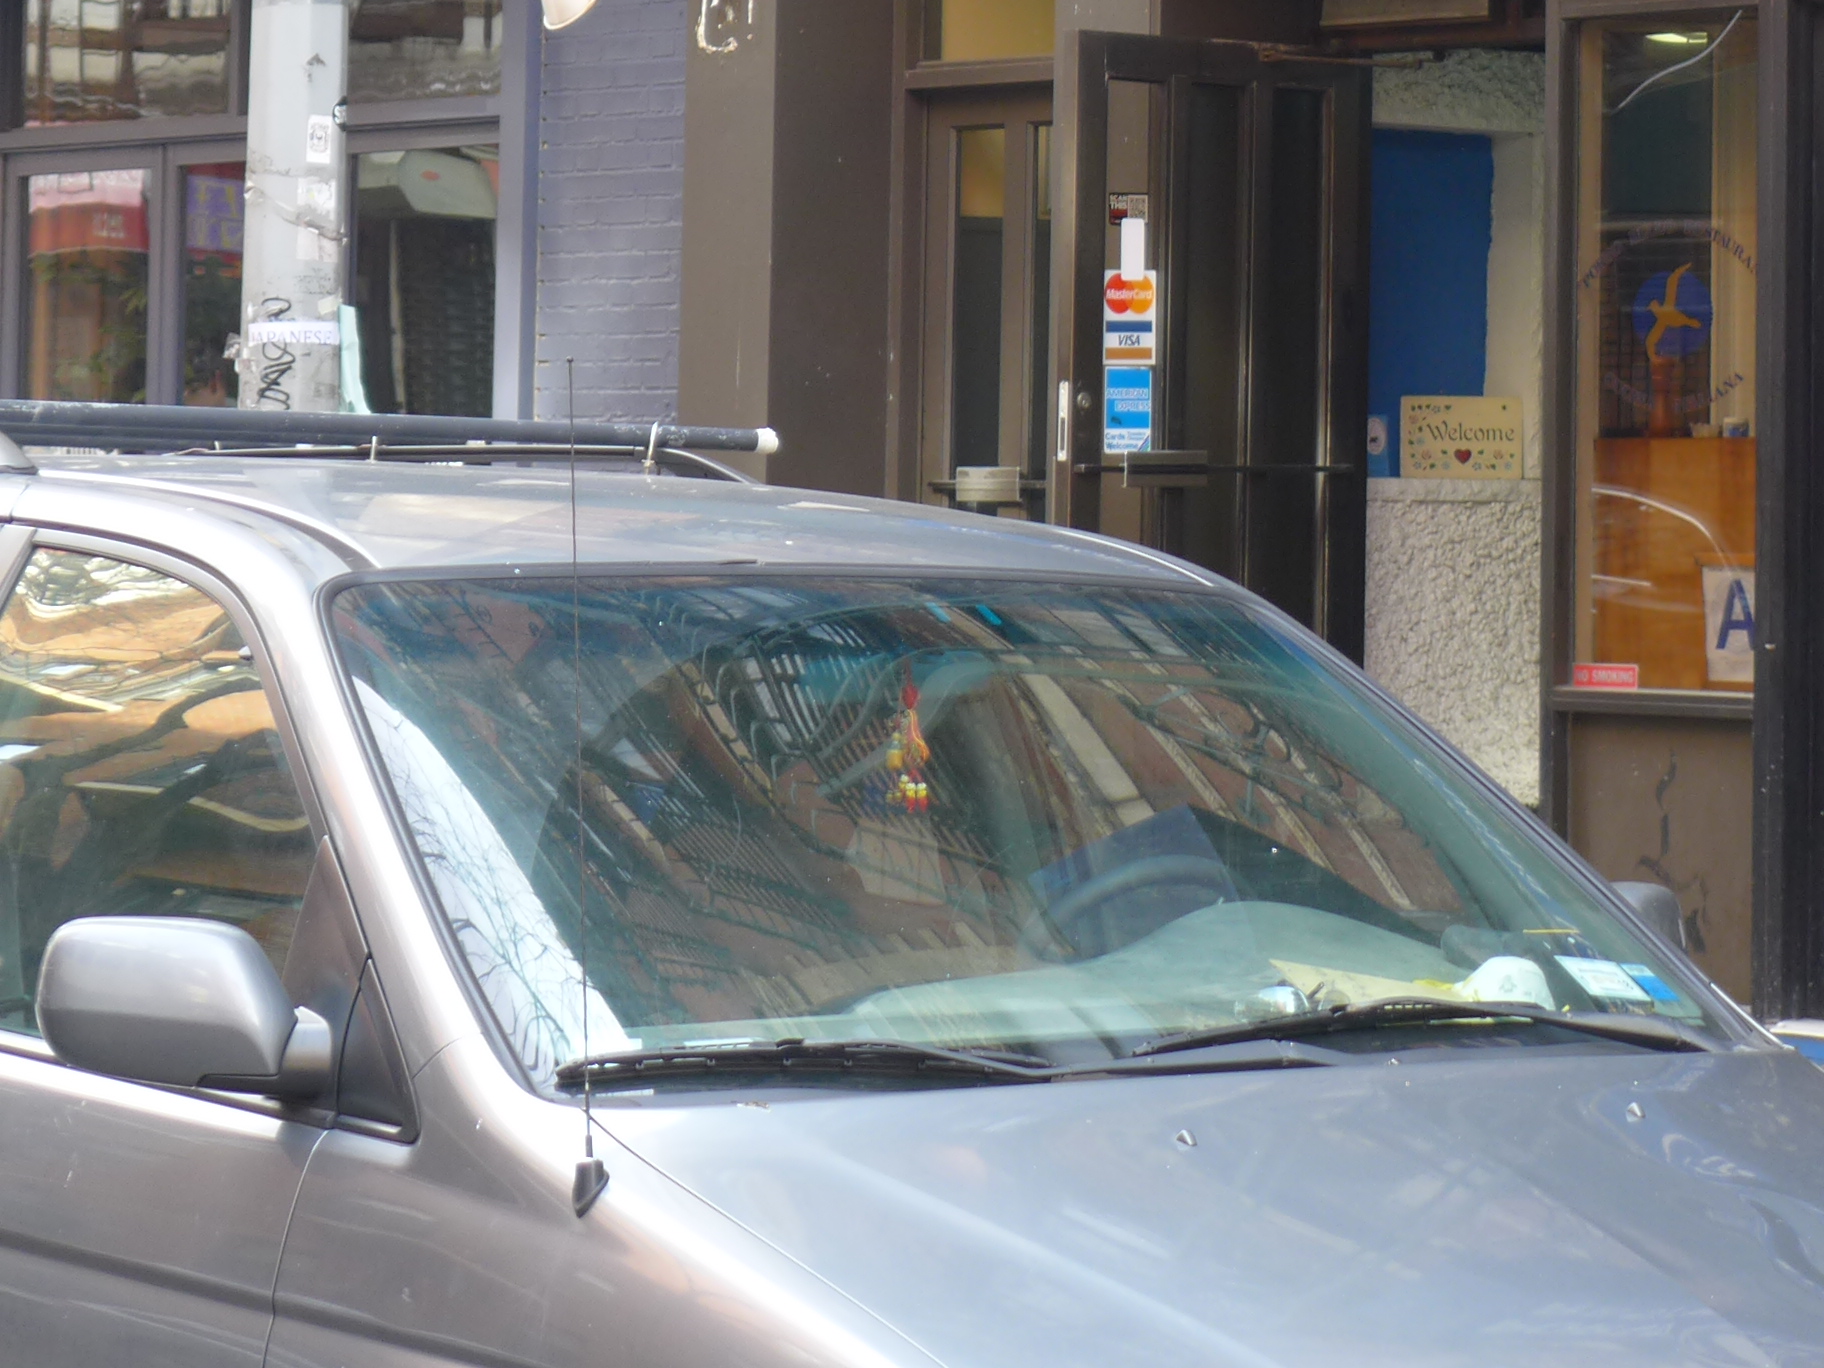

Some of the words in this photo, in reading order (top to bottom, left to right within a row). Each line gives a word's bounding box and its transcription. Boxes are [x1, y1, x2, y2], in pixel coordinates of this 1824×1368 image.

[1118, 334, 1140, 346] VISA
[1427, 419, 1515, 442] Welcome
[1715, 578, 1757, 651] A
[1575, 671, 1588, 682] NO
[1592, 670, 1634, 683] SMOKING
